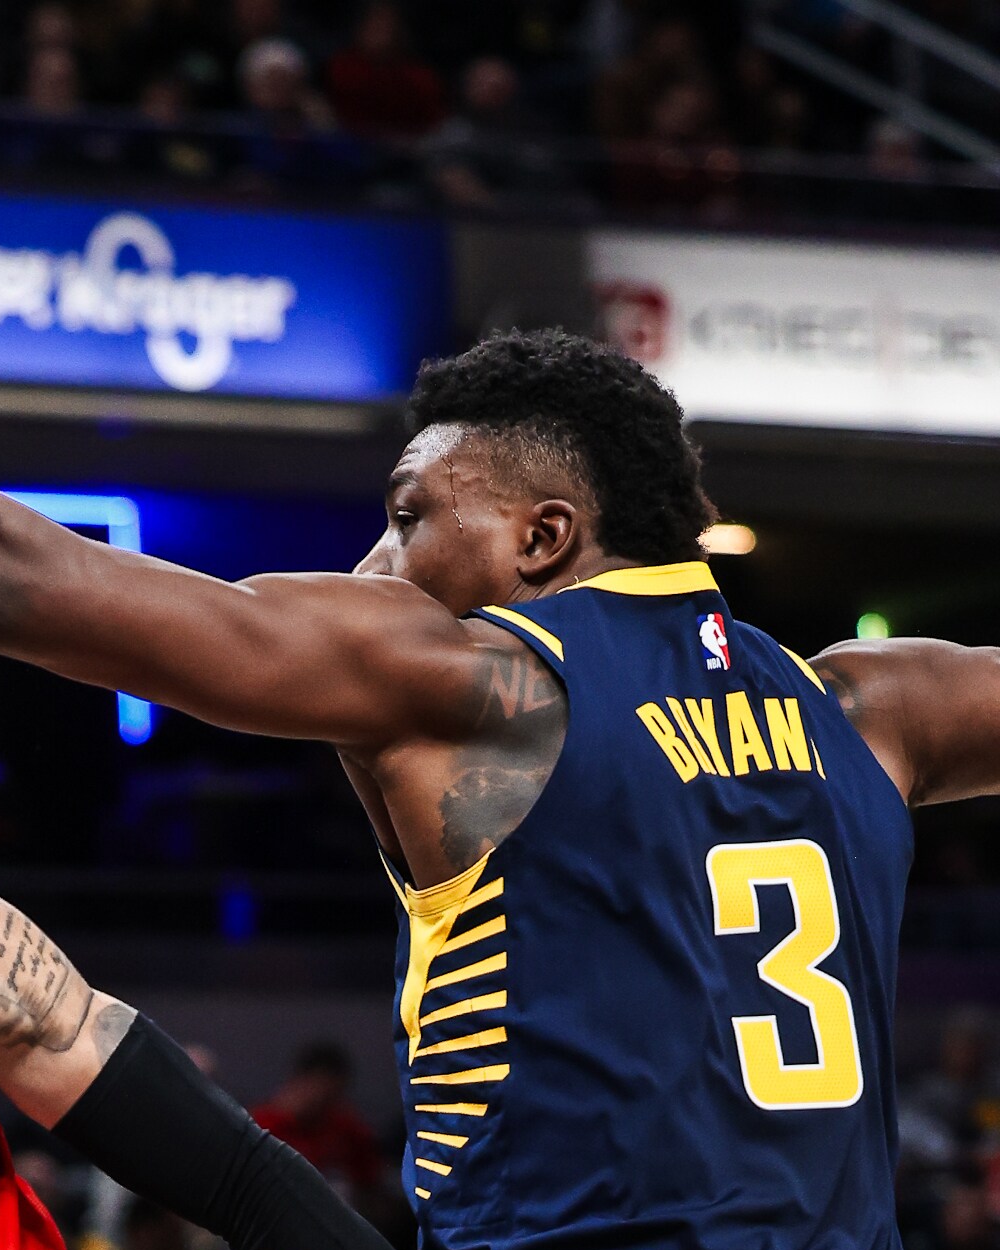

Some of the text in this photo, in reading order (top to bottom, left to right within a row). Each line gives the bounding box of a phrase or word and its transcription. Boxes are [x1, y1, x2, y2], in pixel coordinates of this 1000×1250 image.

[706, 656, 722, 670] NBA
[635, 690, 827, 782] BRYAN
[705, 838, 864, 1111] 3
